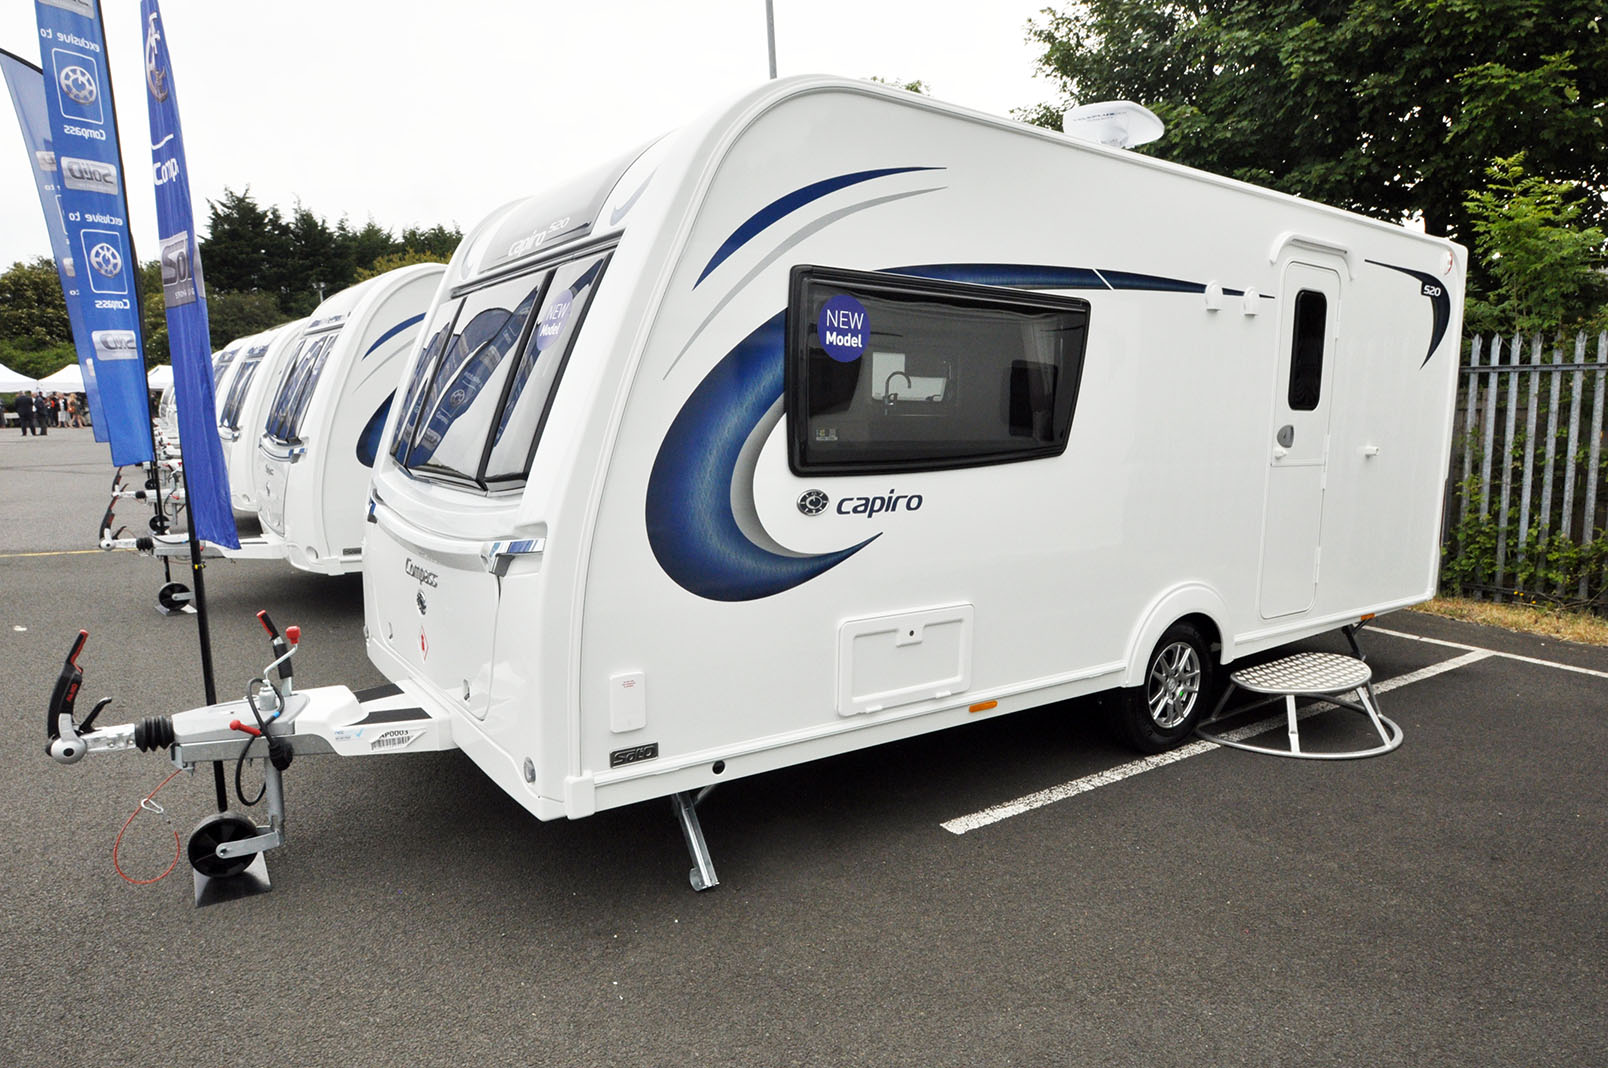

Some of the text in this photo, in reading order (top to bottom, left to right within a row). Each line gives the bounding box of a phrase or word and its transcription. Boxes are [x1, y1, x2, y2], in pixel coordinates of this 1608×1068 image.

[1423, 285, 1441, 297] 520
[546, 302, 570, 320] NEW
[826, 309, 864, 330] NEW
[540, 322, 560, 337] Model
[825, 331, 863, 348] Model
[836, 489, 923, 518] capiro
[405, 557, 438, 588] Compass
